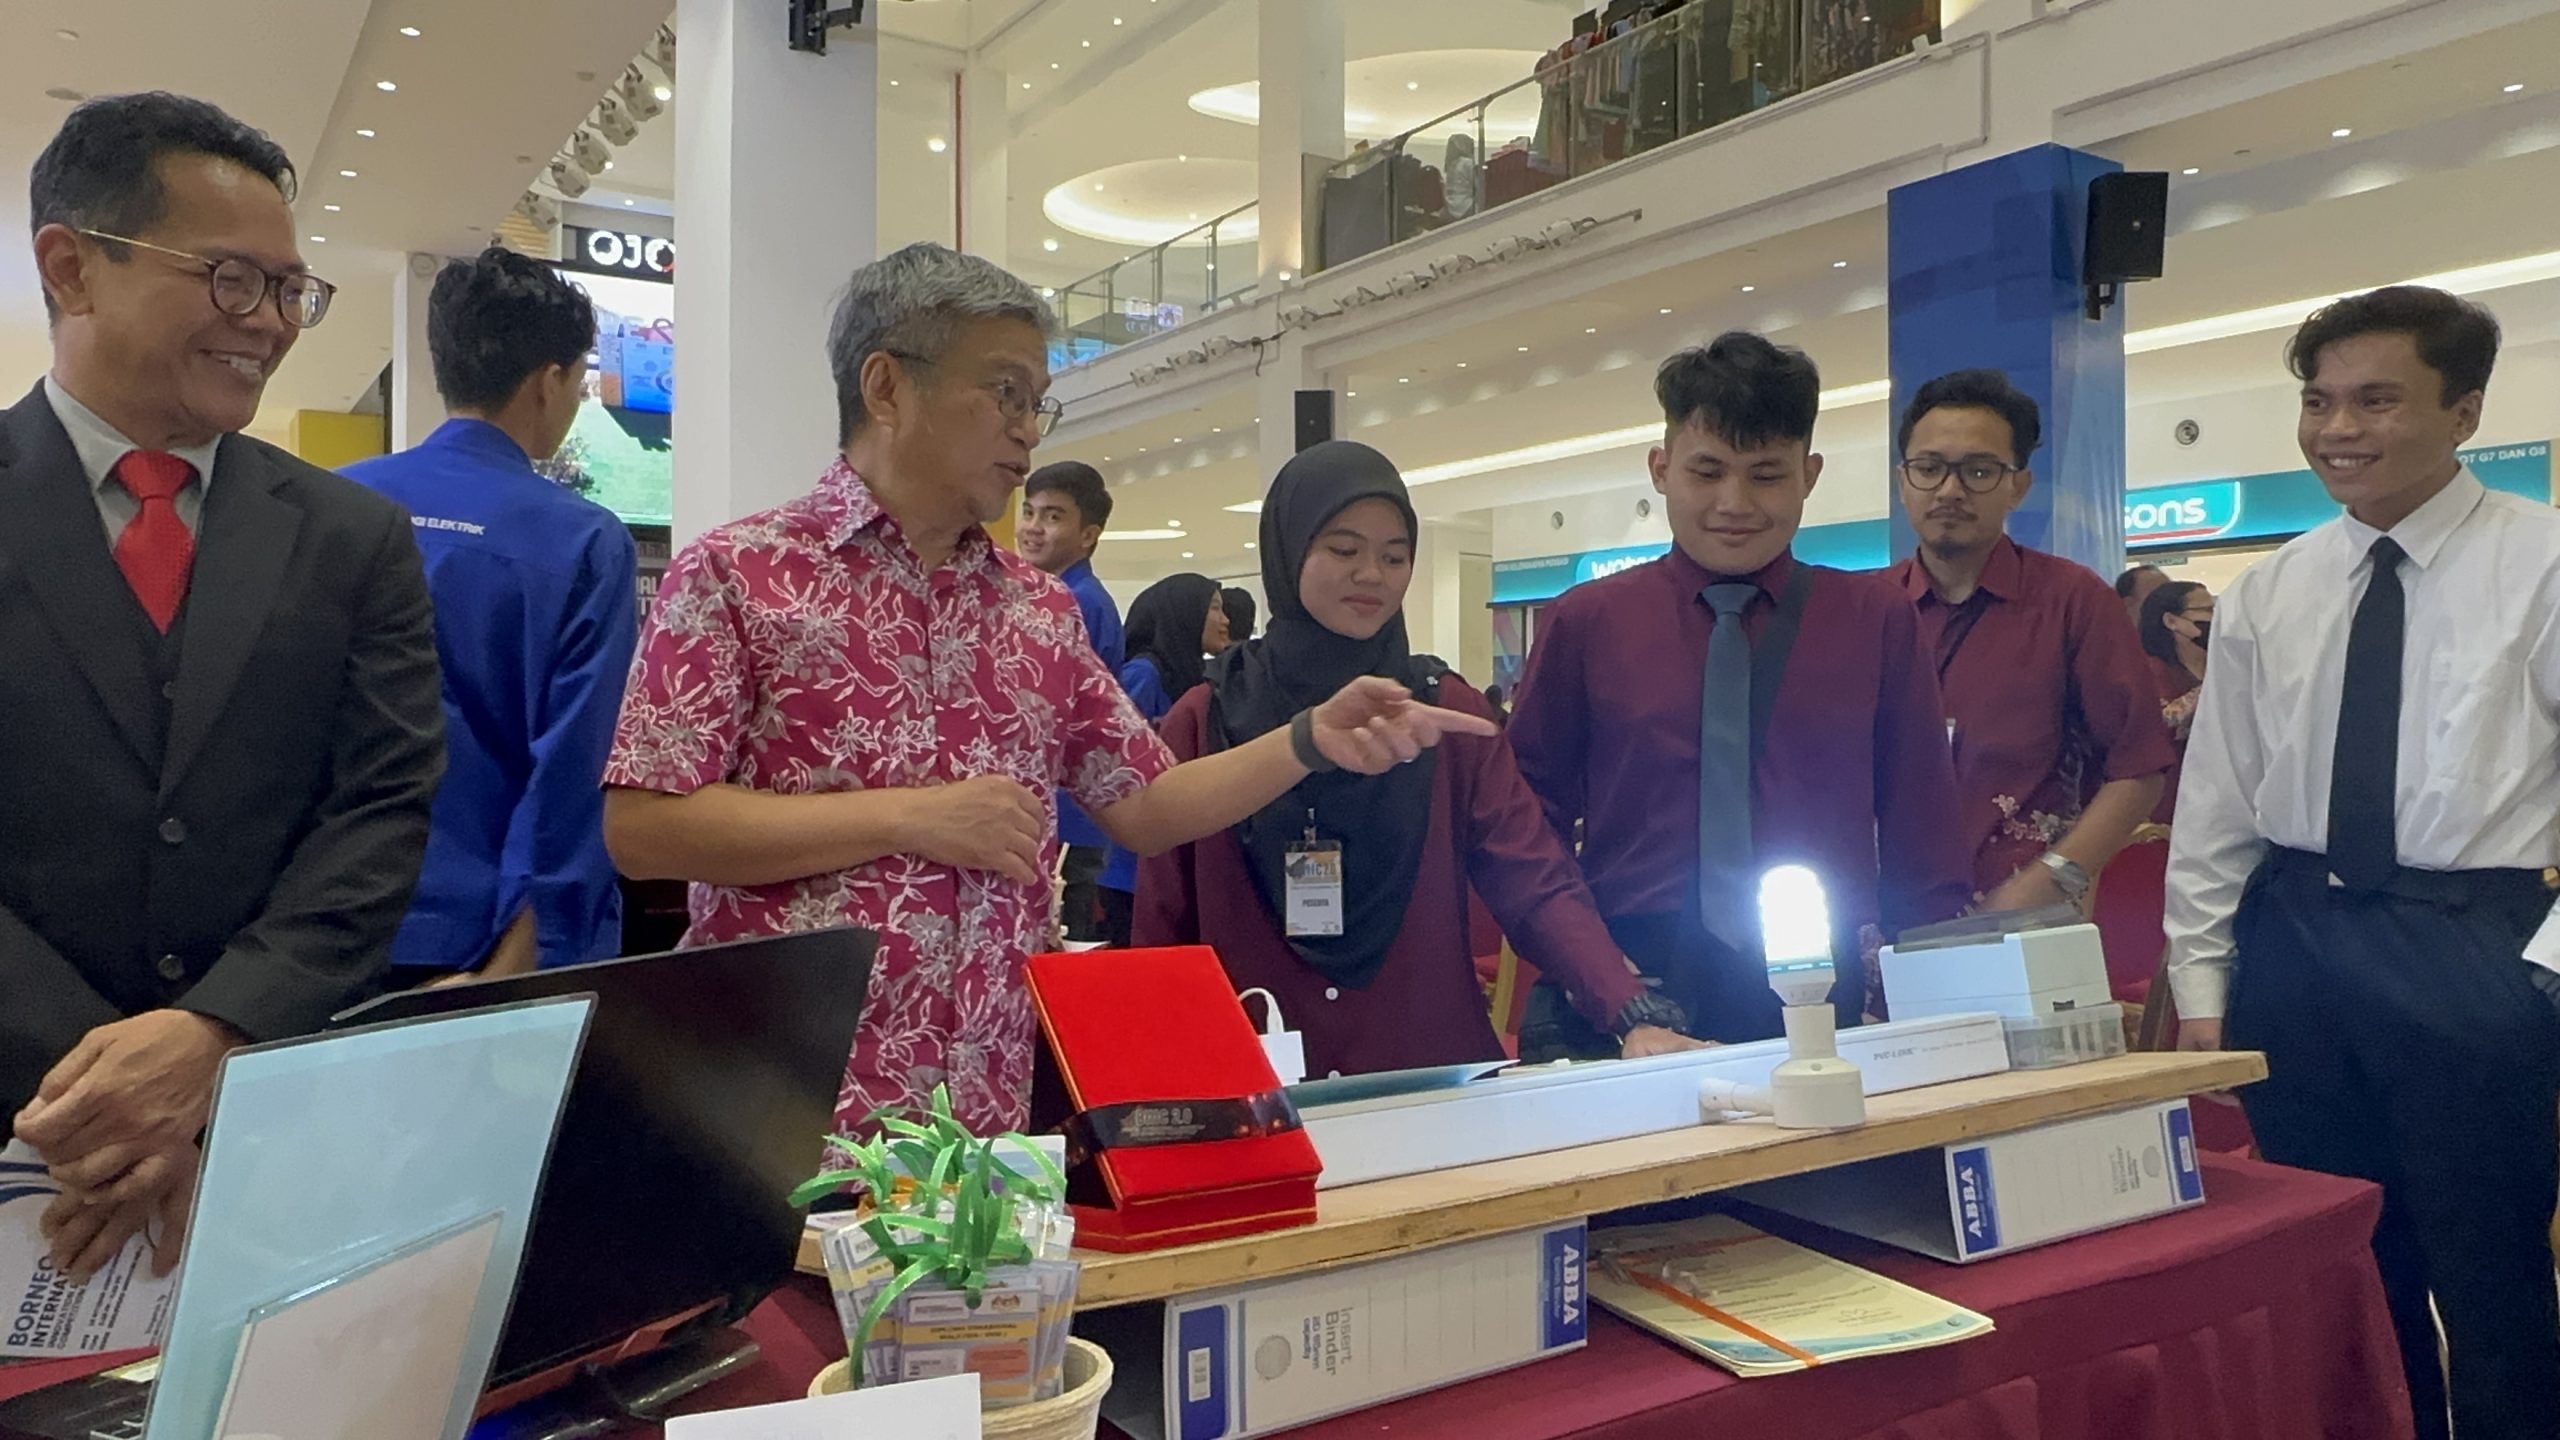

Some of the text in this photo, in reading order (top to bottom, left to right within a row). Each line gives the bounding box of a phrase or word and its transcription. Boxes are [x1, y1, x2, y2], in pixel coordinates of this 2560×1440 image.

[2459, 454, 2476, 464] OT
[2499, 448, 2526, 460] DAN
[427, 518, 486, 535] ELEKTRIK
[1961, 1167, 1983, 1238] ABBA
[30, 1270, 71, 1347] INTERNAT
[1563, 1243, 1580, 1325] ABBA
[1325, 1310, 1339, 1376] Binder
[1340, 1306, 1354, 1365] Insert
